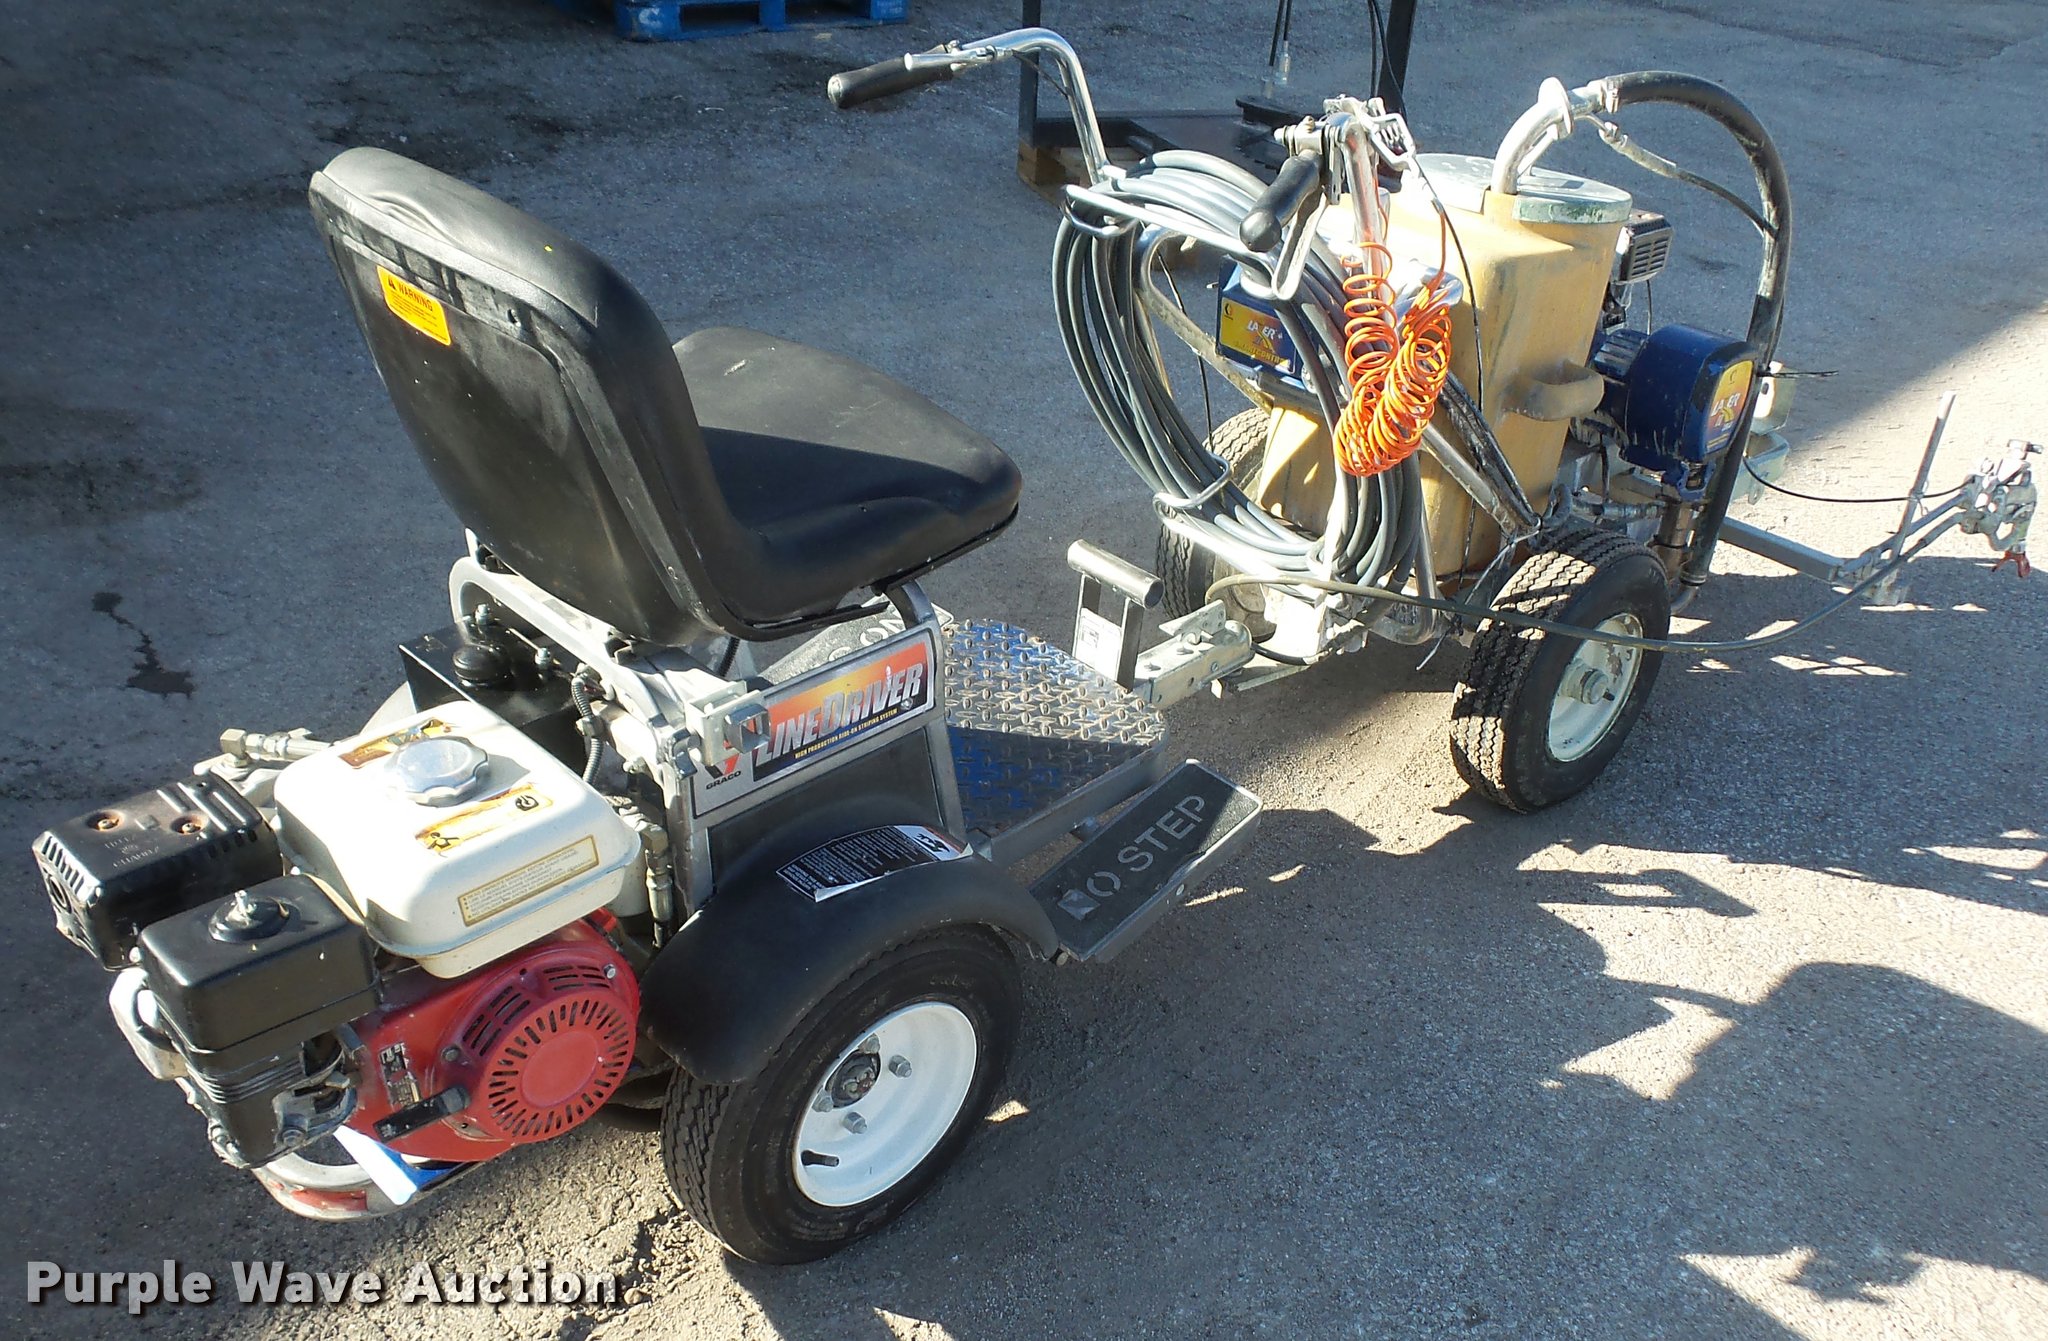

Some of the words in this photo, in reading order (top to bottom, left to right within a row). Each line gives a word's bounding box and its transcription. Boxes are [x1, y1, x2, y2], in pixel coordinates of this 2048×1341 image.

[880, 708, 898, 723] SYSTEM
[705, 770, 742, 790] GRACO
[1117, 795, 1206, 872] STEP
